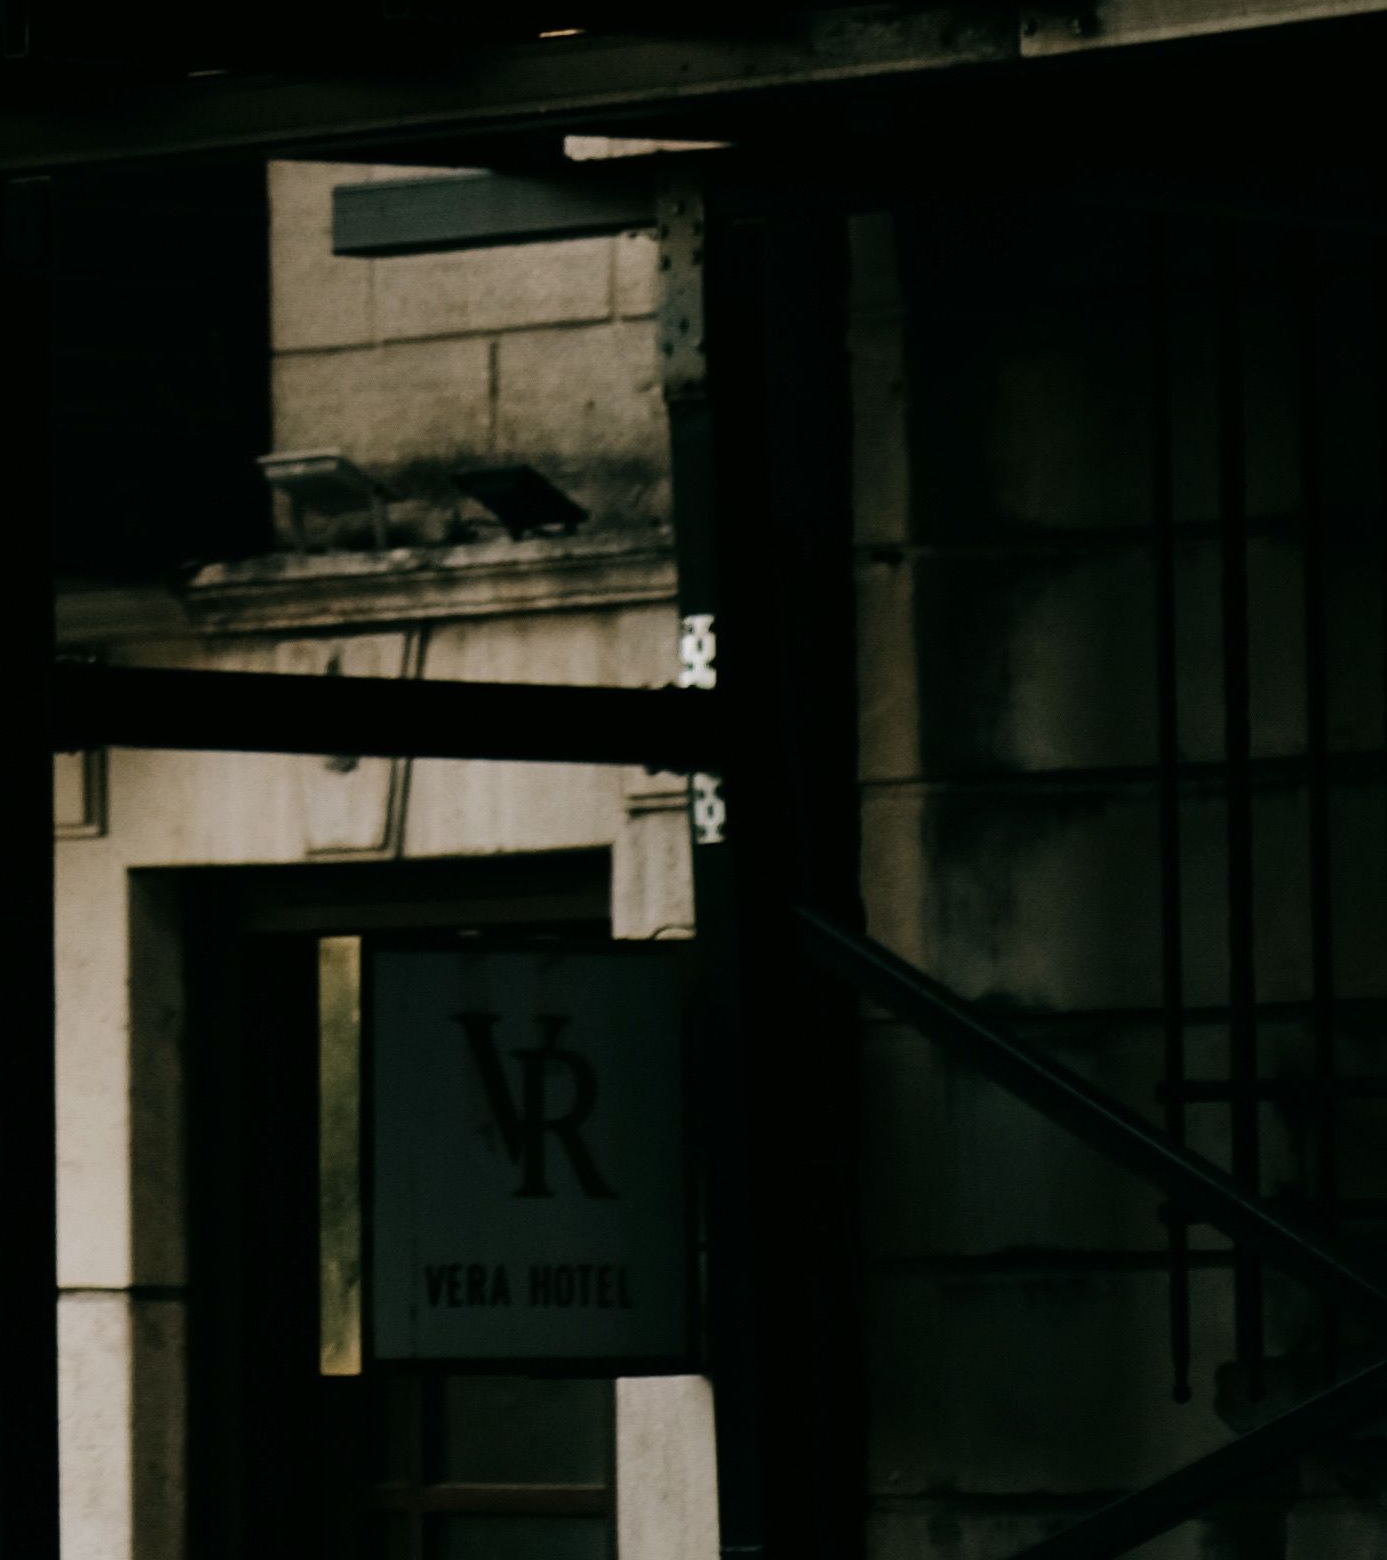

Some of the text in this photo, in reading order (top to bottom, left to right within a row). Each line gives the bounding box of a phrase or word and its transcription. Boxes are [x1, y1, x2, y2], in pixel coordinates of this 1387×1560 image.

[451, 1013, 621, 1199] VR
[426, 1264, 634, 1310] VERA HOTEL
